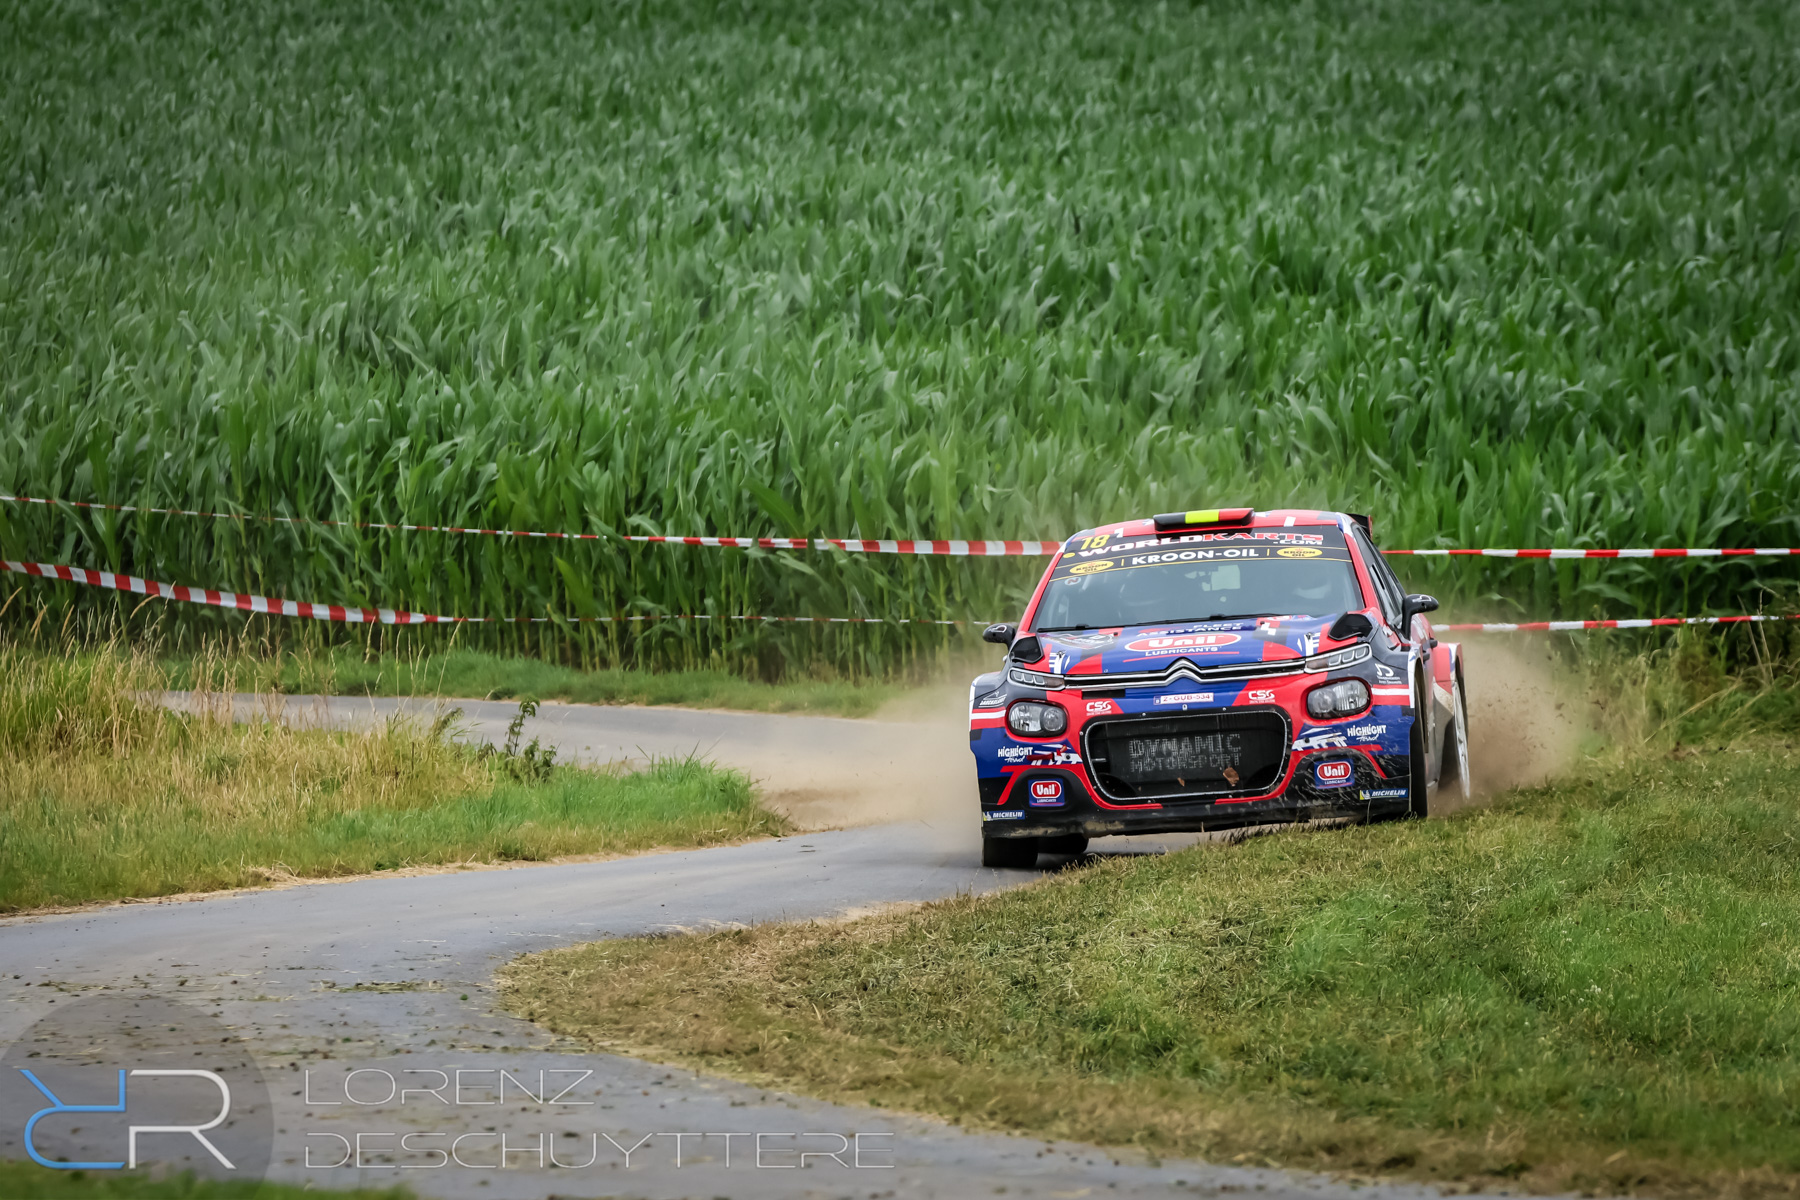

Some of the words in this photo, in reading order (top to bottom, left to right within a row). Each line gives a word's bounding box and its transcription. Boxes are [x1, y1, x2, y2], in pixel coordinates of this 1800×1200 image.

[1080, 534, 1111, 550] 18
[1131, 548, 1259, 565] KROON-OIL
[1148, 635, 1217, 648] Unil
[1145, 646, 1218, 656] LUBRICANTS
[1323, 764, 1345, 777] Unil
[1036, 784, 1056, 796] Unil
[1371, 789, 1407, 797] MICHELIN
[992, 811, 1023, 819] MICHELIN
